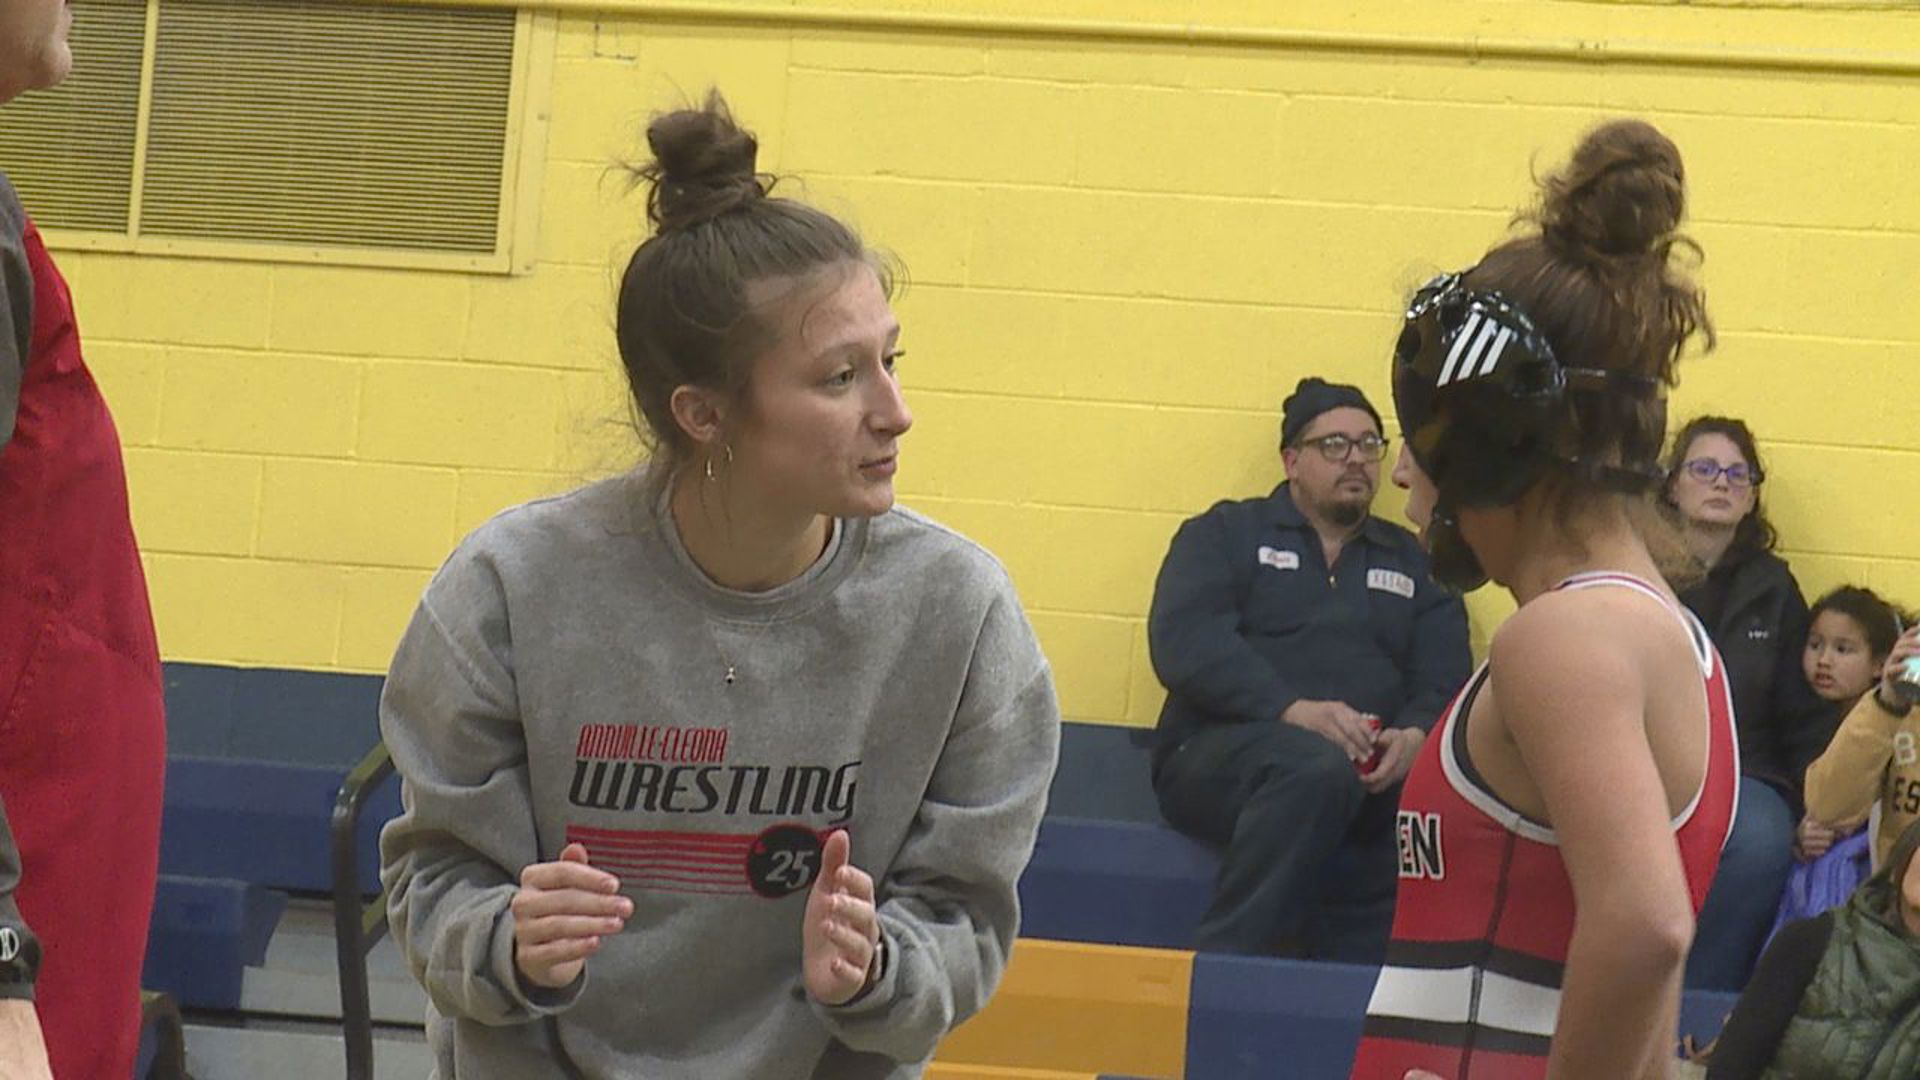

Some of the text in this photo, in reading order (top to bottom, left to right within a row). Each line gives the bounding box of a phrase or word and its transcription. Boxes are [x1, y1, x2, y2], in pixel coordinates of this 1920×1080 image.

[576, 723, 729, 763] ANNVILLE-CLEONA
[568, 760, 862, 825] WRESTLING
[765, 850, 814, 889] 25
[1397, 810, 1445, 880] EN
